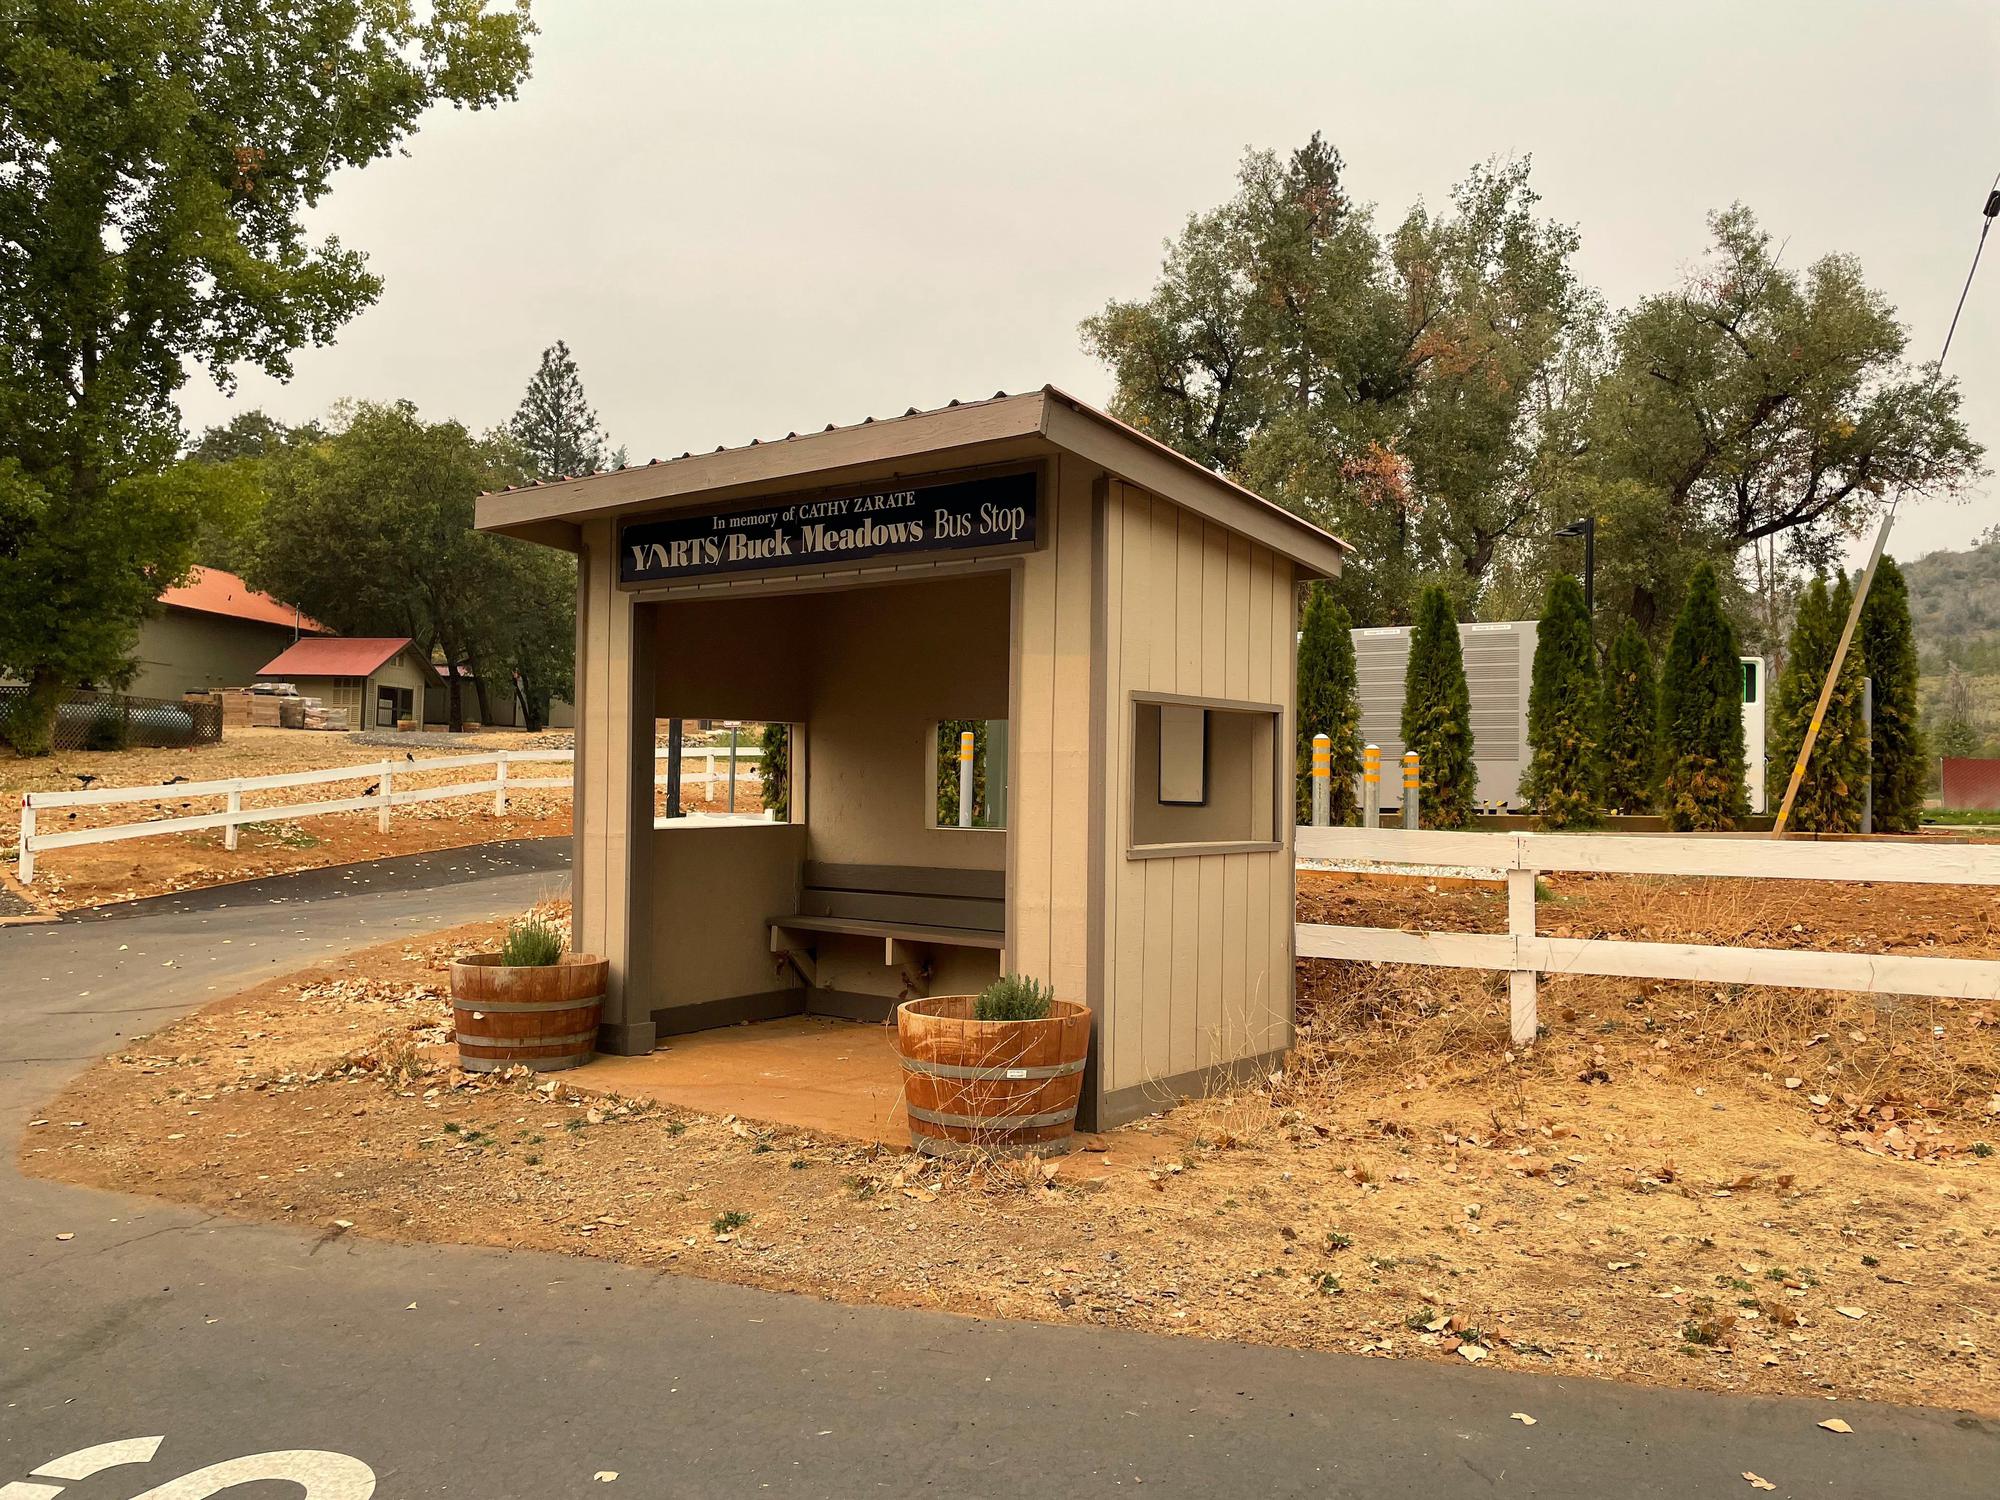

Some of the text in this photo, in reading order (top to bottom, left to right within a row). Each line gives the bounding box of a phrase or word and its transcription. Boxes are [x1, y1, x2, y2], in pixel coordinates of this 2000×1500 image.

[712, 491, 916, 530] In memory of CATHY ZARATE
[800, 517, 924, 554] Meadows
[934, 508, 972, 540] Bus
[979, 502, 1025, 541] Stop
